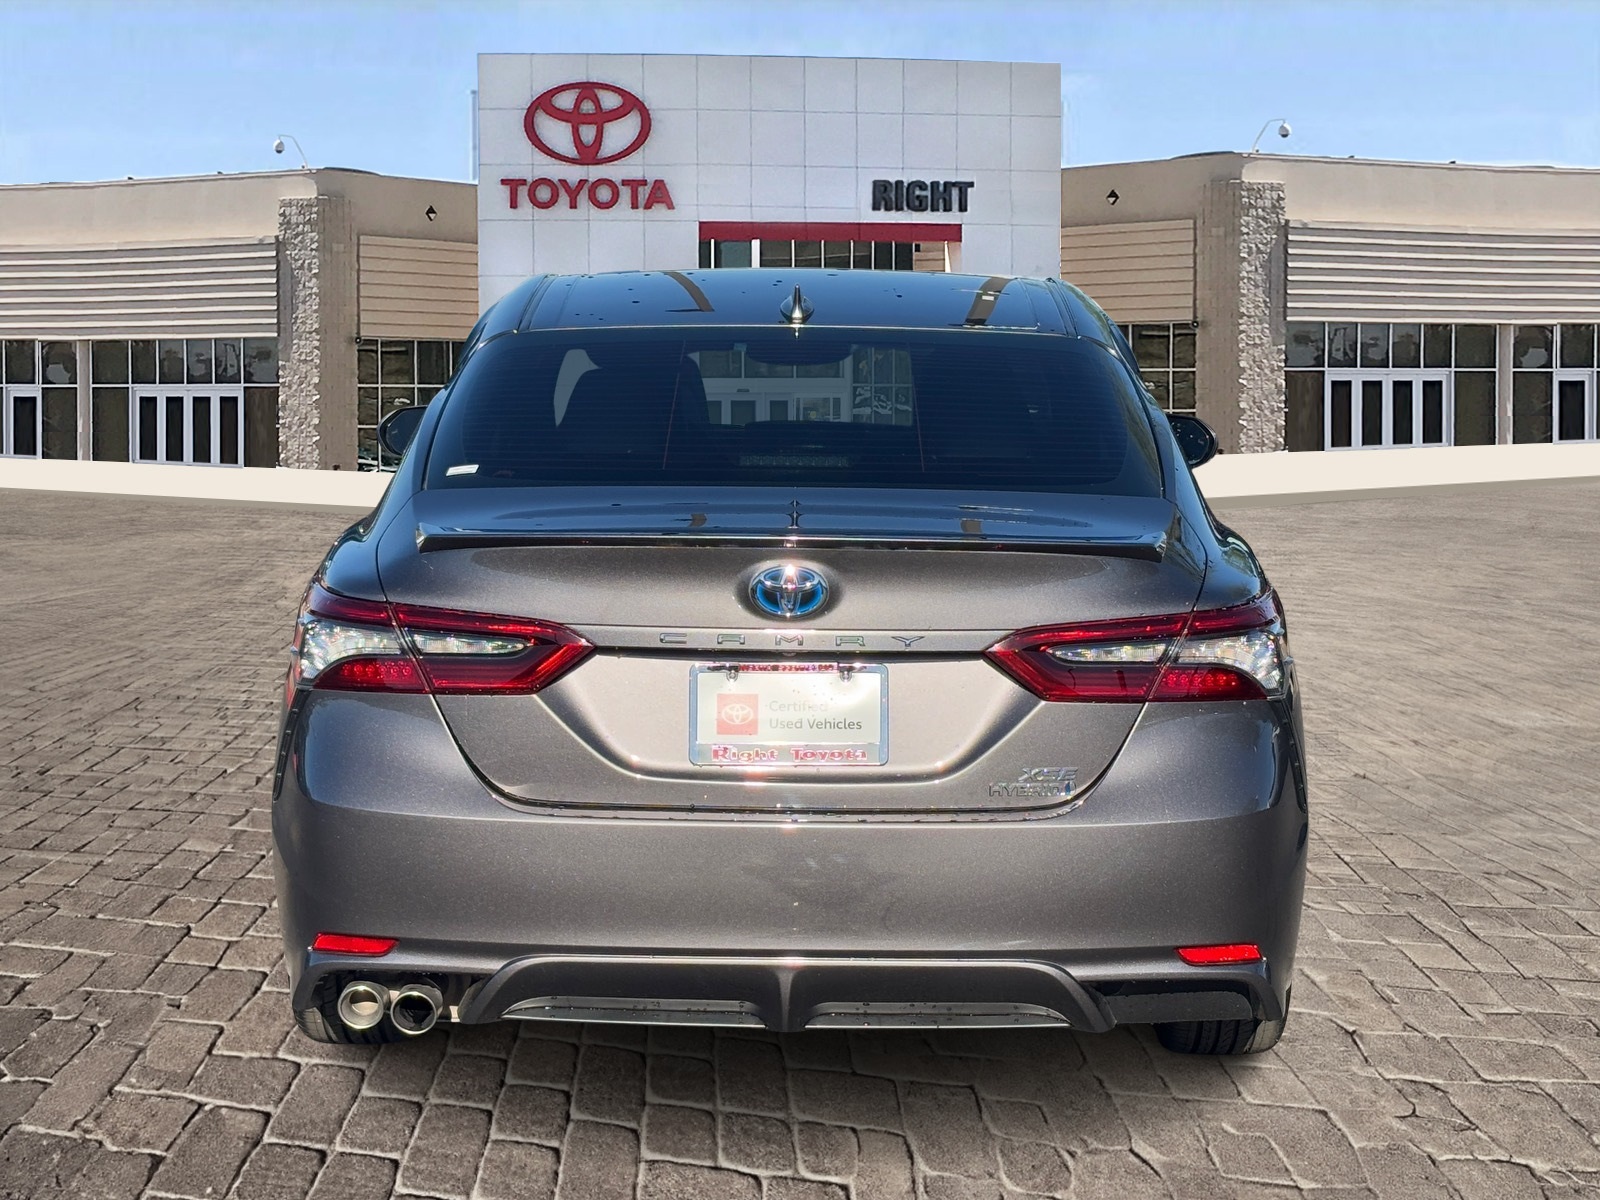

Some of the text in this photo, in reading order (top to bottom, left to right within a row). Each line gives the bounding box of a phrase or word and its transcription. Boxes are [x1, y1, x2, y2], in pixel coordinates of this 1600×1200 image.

[500, 178, 675, 210] TOYOTA
[872, 180, 975, 212] RIGHT
[659, 633, 925, 648] CAMRY
[769, 700, 828, 712] Certified
[769, 718, 862, 730] Used Vehicles
[711, 745, 867, 762] Right Toyota
[1019, 767, 1078, 781] XSE
[988, 782, 1060, 798] HYBRID
